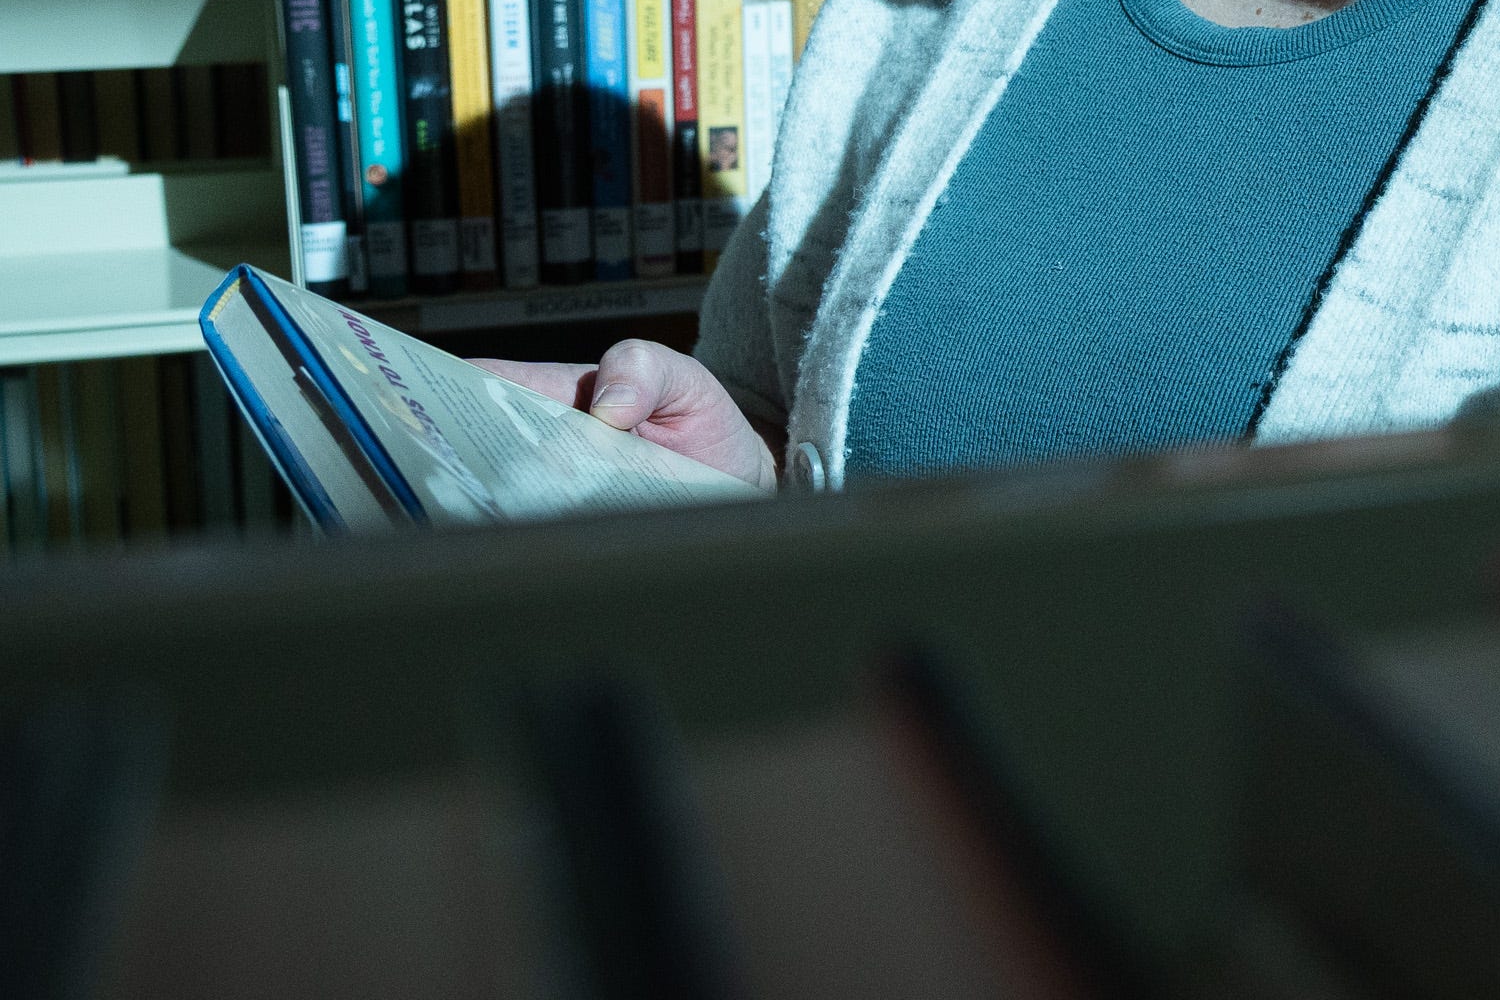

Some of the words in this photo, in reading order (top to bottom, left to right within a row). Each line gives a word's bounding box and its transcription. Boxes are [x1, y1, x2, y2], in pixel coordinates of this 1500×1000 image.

[424, 4, 441, 49] WITH
[643, 5, 658, 64] VULTURE
[526, 289, 648, 317] BIOGRAPHIES
[378, 364, 409, 390] TO
